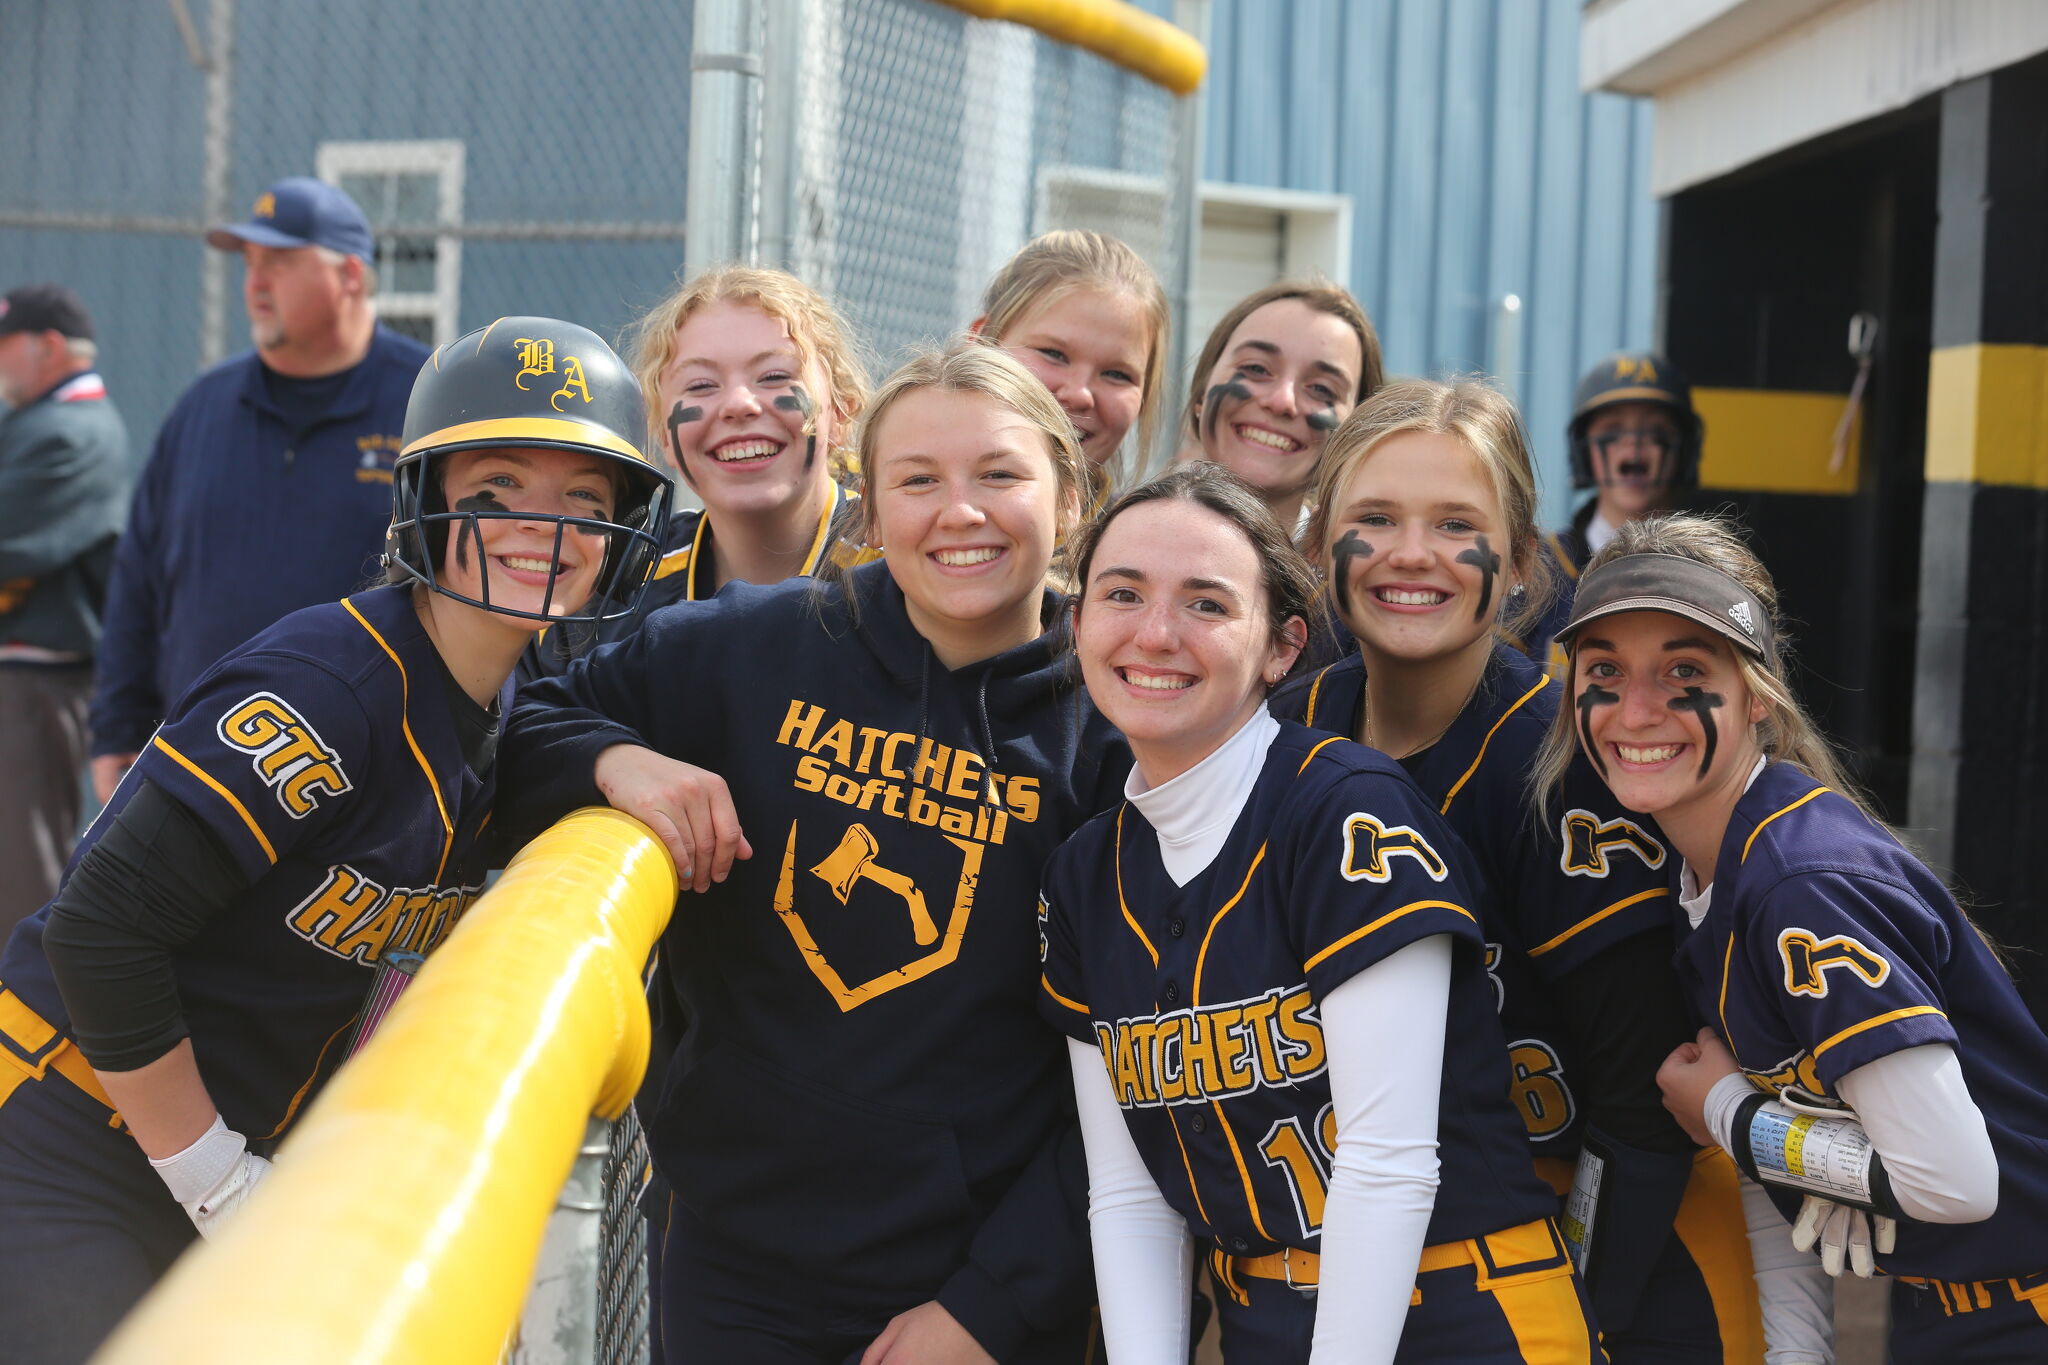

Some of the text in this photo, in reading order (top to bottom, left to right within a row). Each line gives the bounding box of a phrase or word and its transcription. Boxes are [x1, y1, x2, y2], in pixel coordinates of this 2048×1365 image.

[1728, 608, 1755, 635] adidas
[216, 691, 354, 820] GTC
[793, 756, 1009, 845] Softball
